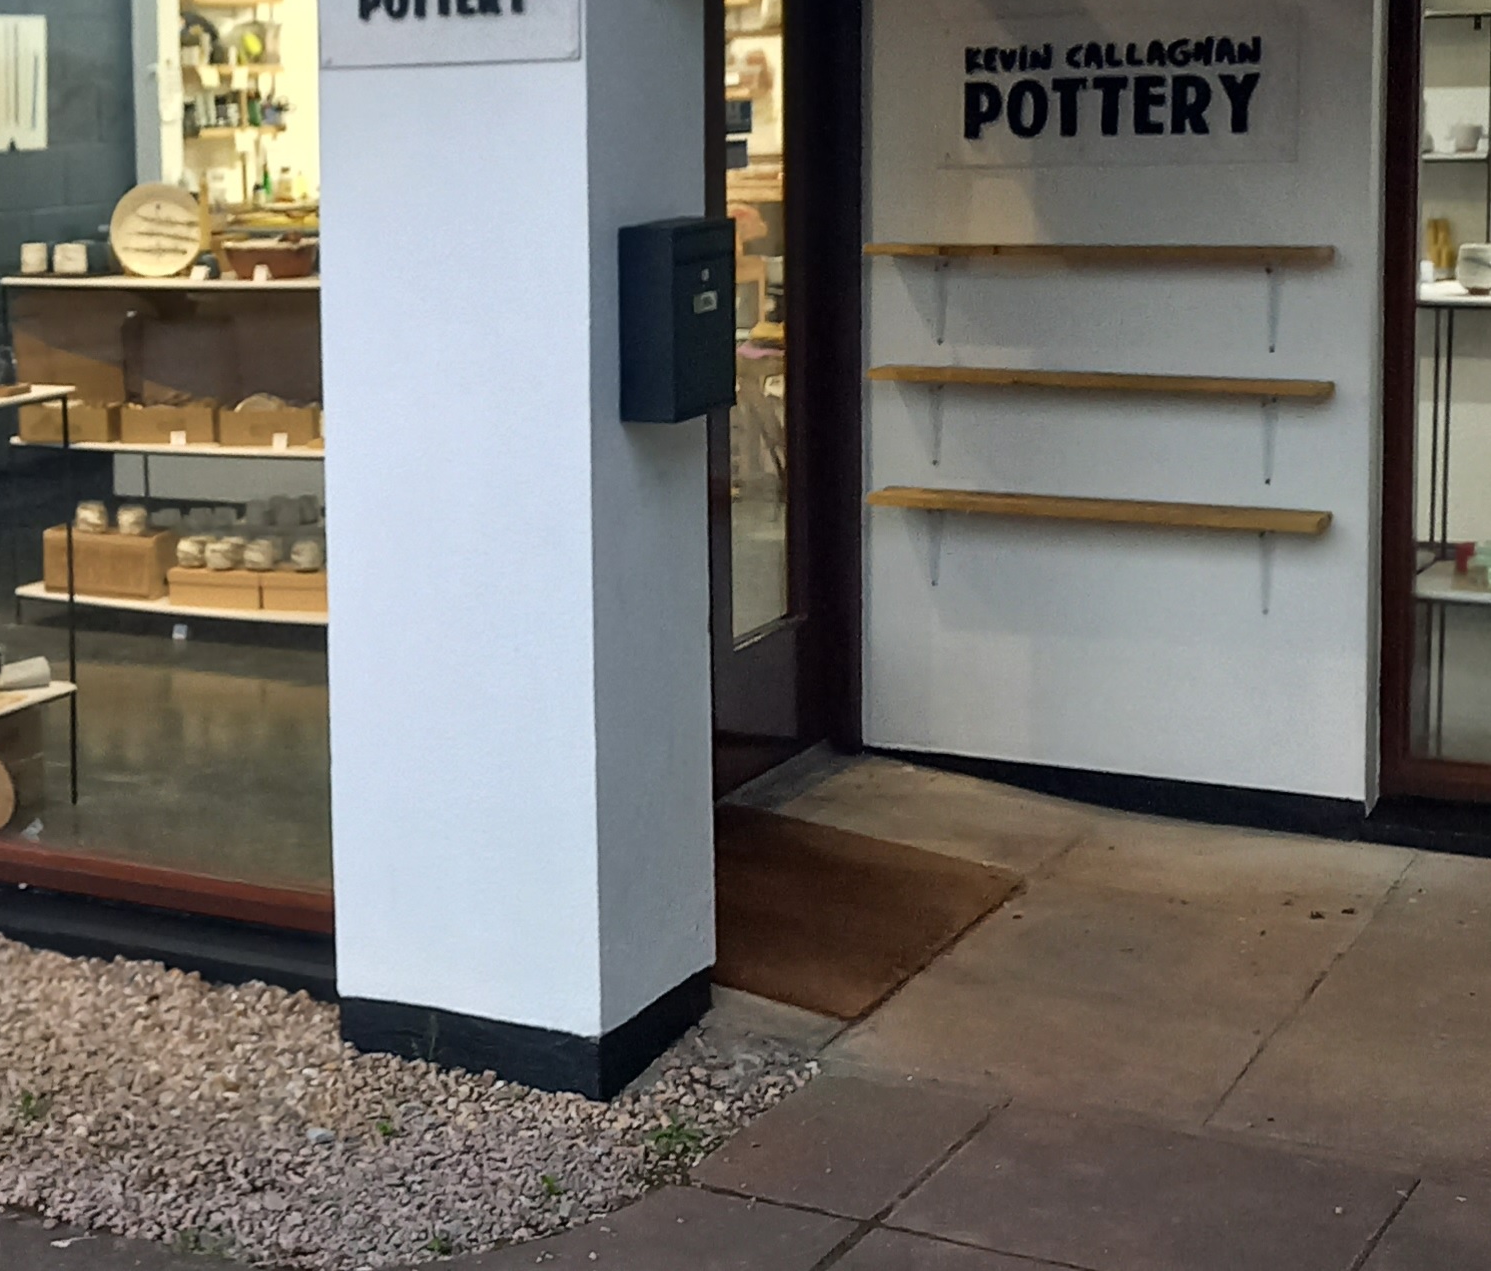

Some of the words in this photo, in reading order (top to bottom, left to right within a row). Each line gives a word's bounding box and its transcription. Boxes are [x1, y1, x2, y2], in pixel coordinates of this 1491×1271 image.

[964, 43, 1054, 75] KEVIN
[1065, 35, 1262, 70] CALLAGHAN
[963, 72, 1261, 140] POTTERY
